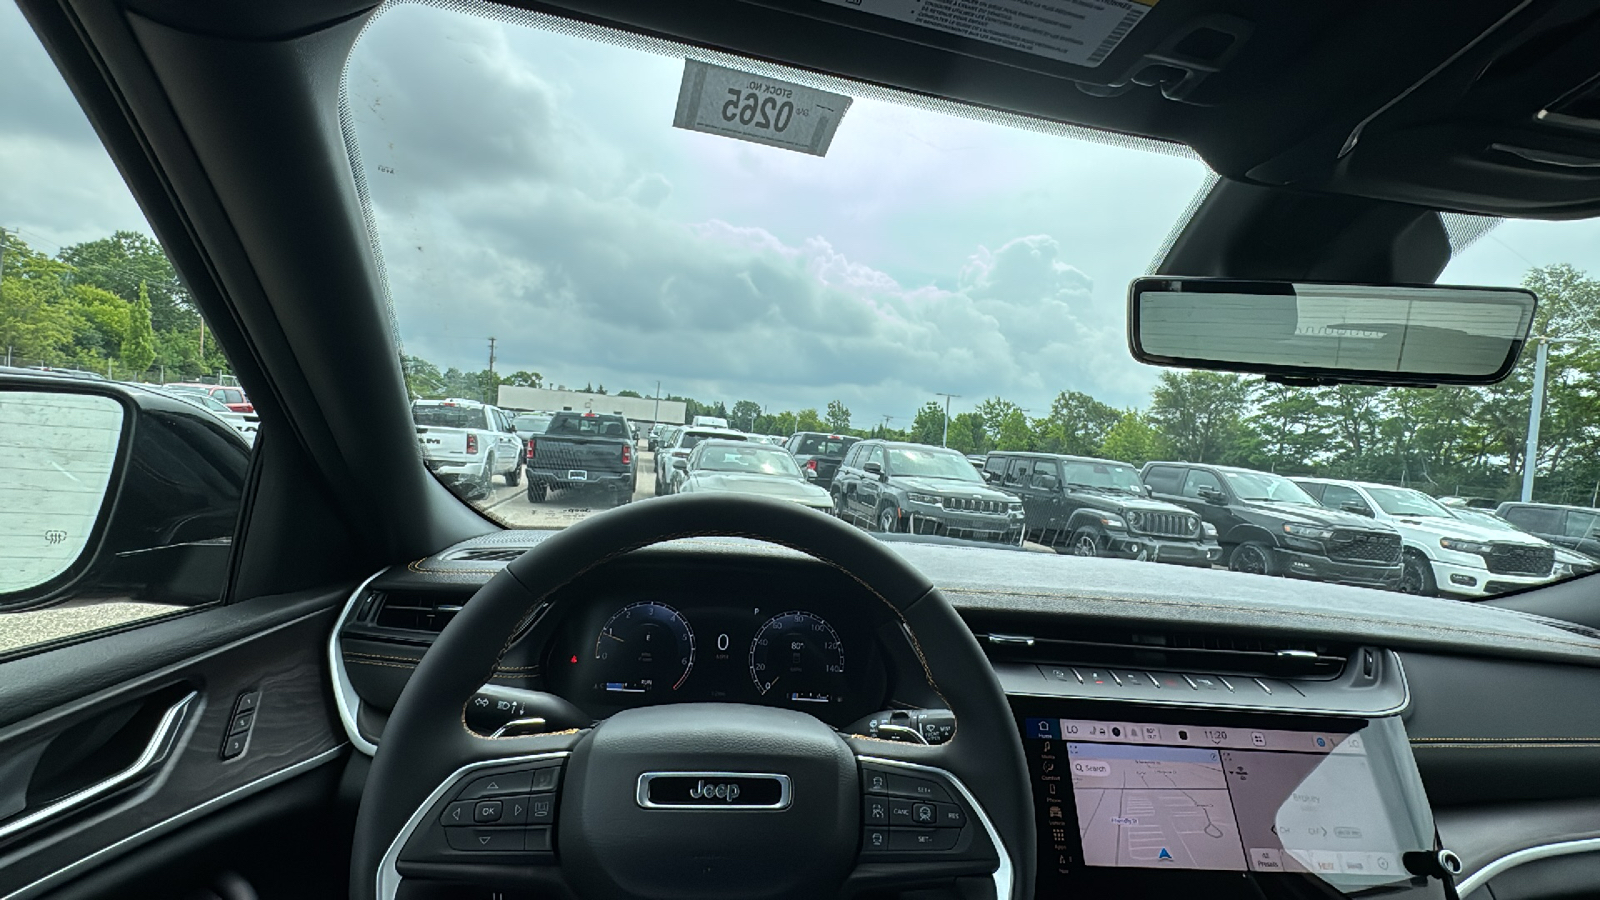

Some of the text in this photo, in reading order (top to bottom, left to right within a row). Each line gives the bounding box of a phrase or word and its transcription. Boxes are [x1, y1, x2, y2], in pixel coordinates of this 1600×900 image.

[754, 607, 760, 615] P
[717, 633, 729, 650] 0
[1066, 724, 1079, 734] LO
[1204, 730, 1227, 739] 11:20
[1085, 764, 1107, 772] Search
[690, 780, 740, 802] Jeep
[482, 807, 495, 816] OK
